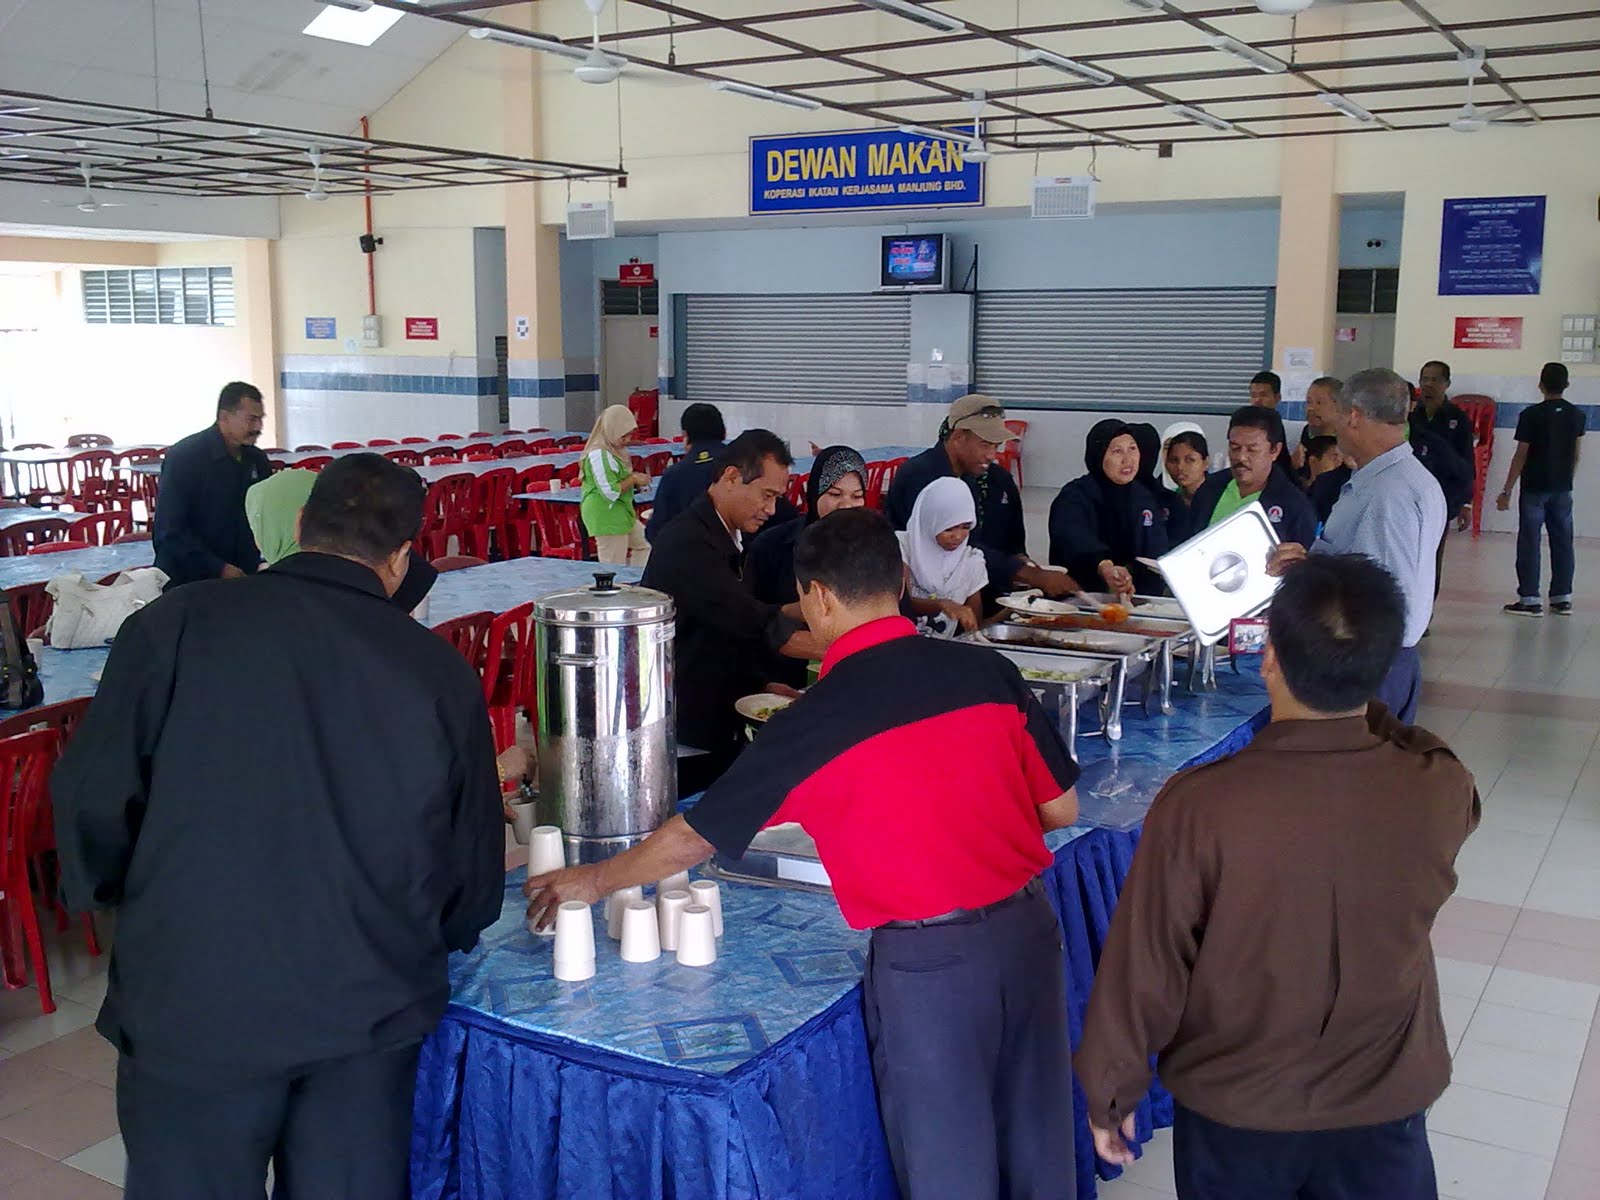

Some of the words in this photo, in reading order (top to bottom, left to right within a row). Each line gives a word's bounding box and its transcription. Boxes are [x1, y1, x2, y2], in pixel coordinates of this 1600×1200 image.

[766, 145, 857, 182] DEWAN
[867, 140, 964, 176] MAKAN
[763, 188, 806, 200] KOPERASI
[808, 186, 839, 198] IKATAN
[842, 183, 895, 196] KERJASAMA
[898, 181, 942, 193] MANJUNG
[944, 180, 967, 191] BHD.
